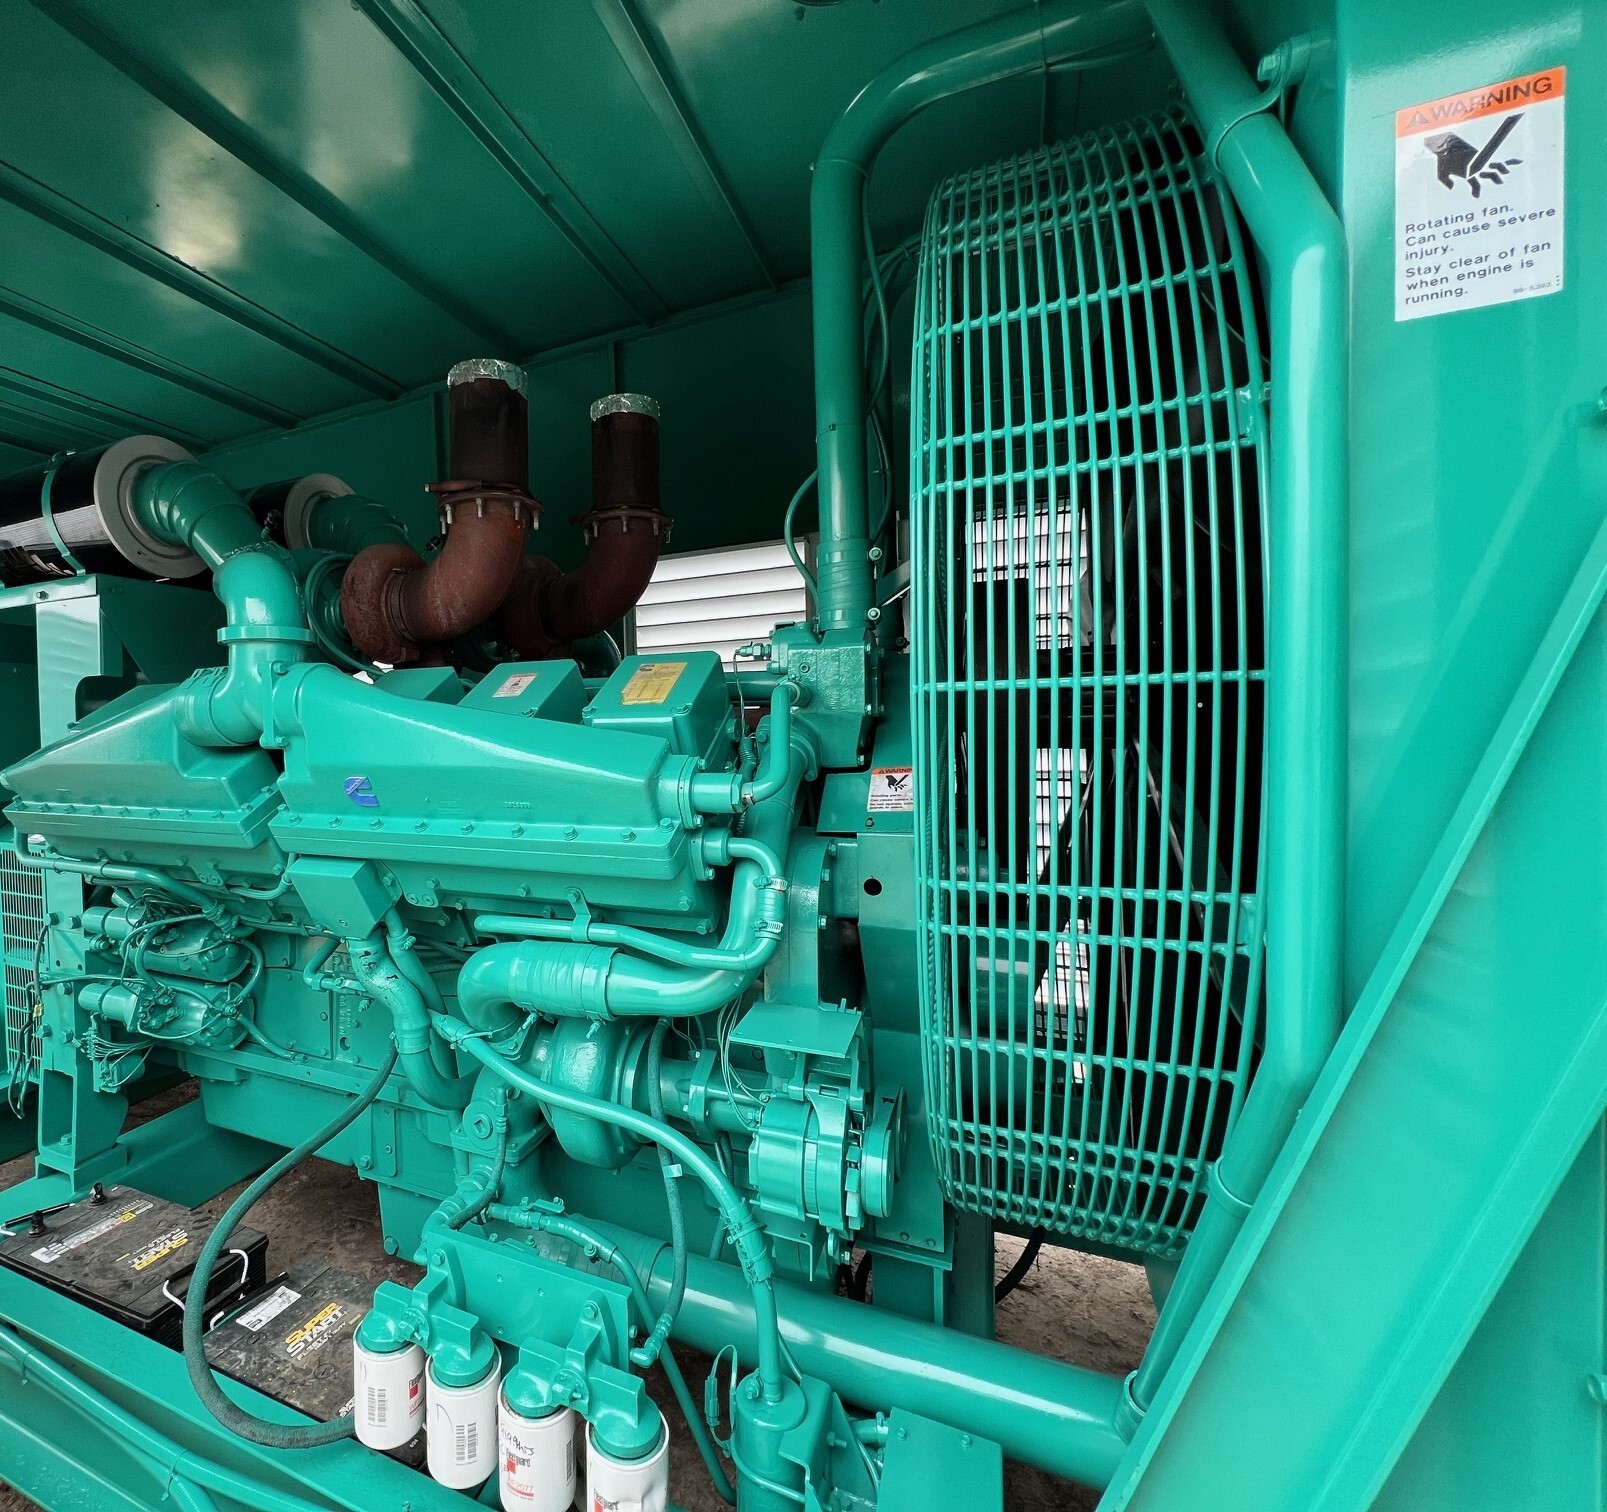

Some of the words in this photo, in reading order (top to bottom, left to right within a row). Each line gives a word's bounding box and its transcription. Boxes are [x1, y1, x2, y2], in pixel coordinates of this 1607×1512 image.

[1430, 77, 1552, 121] WARNING
[1405, 212, 1474, 234] Rotating
[1482, 204, 1514, 217] fan.
[1405, 234, 1436, 247] Can
[1442, 222, 1491, 239] cause
[1498, 208, 1556, 227] severe
[1405, 244, 1454, 260] injury.
[1405, 263, 1441, 278] Stay
[1449, 253, 1490, 270] clear
[1498, 247, 1516, 260] of
[1523, 242, 1551, 254] fan
[1406, 275, 1449, 291] when
[1456, 263, 1512, 281] engine
[1520, 259, 1534, 269] is
[1405, 287, 1469, 305] running.
[285, 1302, 338, 1344] SUPER
[286, 1305, 345, 1357] START
